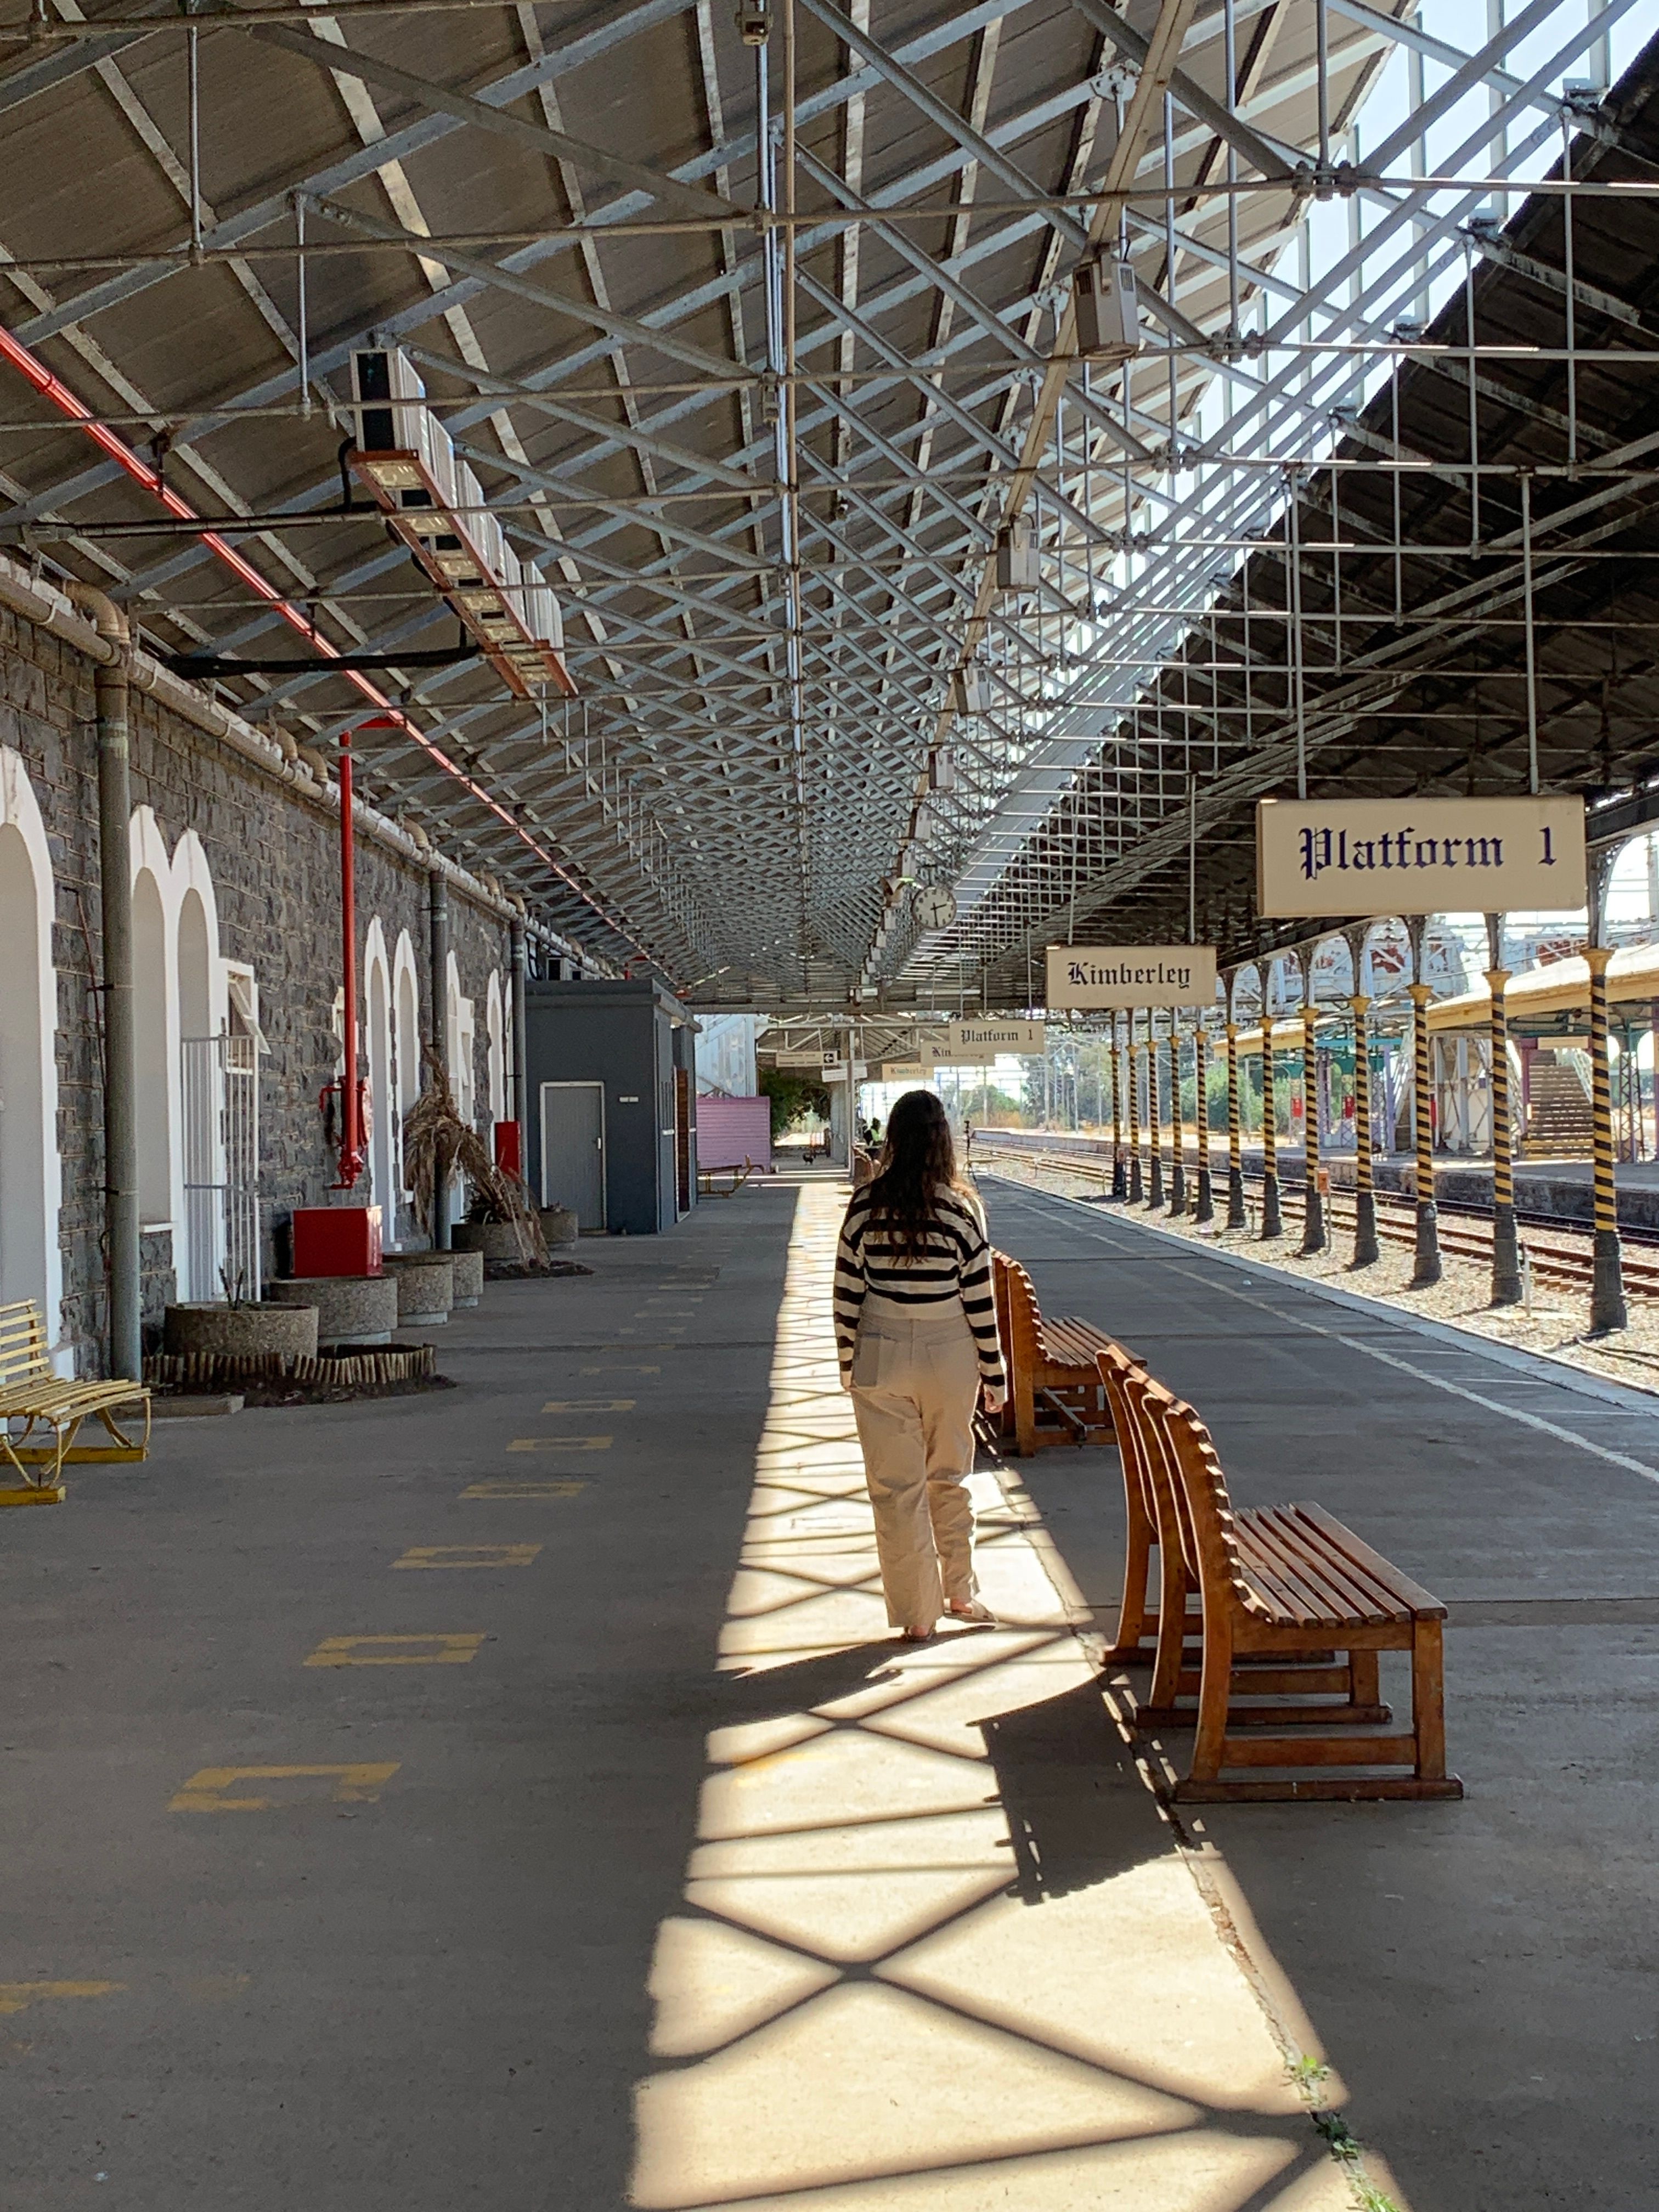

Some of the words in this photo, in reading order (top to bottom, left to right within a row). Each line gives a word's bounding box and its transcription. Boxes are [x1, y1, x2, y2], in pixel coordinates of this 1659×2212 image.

[1298, 826, 1504, 881] Platform
[1538, 826, 1557, 866] 1
[1067, 961, 1191, 989] Kimberley
[961, 1029, 1019, 1045] Platform
[1028, 1029, 1033, 1041] 1
